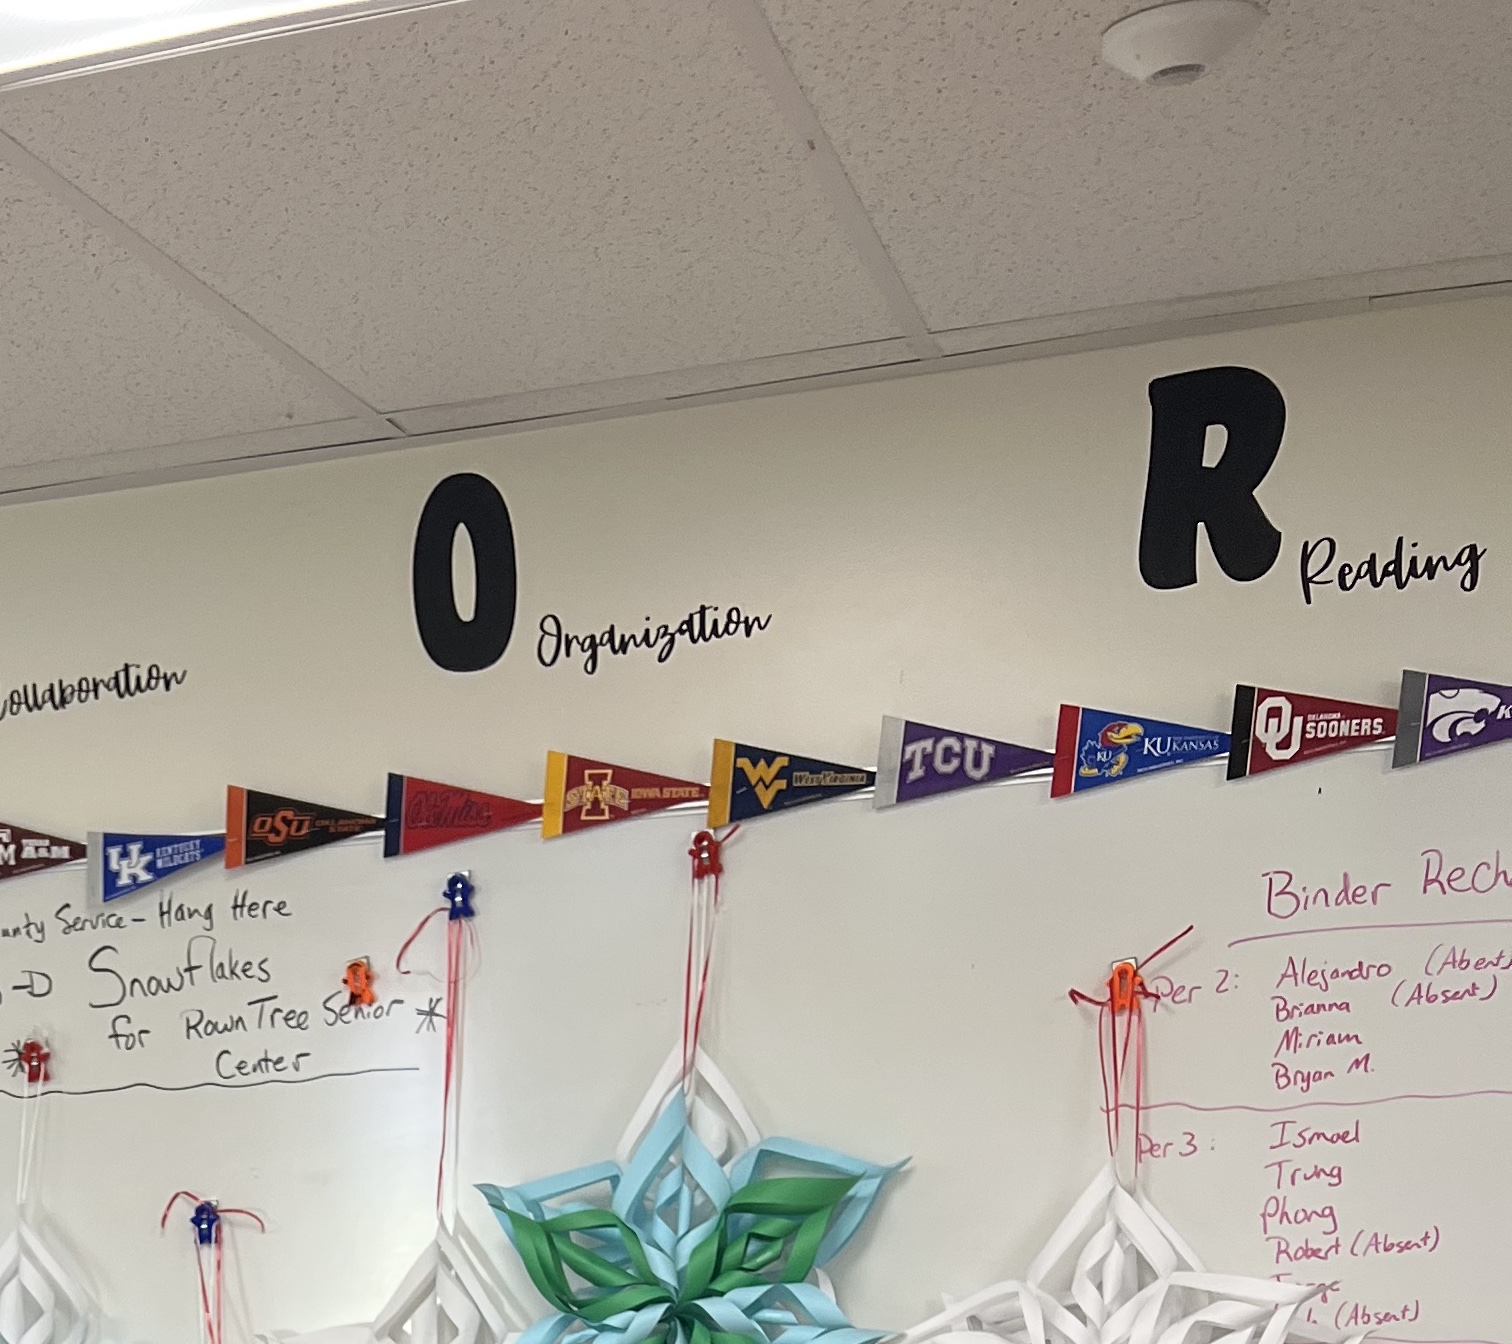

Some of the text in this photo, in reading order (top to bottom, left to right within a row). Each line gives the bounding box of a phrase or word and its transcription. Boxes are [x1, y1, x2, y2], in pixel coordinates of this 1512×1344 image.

[1138, 366, 1287, 589] R
[413, 472, 516, 672] O
[1300, 537, 1487, 604] Reading
[537, 607, 772, 674] Organization
[1172, 740, 1219, 752] KANSAS
[1305, 717, 1384, 739] SOONERS
[904, 737, 996, 784] TCU
[251, 808, 314, 845] OSU
[159, 891, 214, 931] Hang
[232, 888, 293, 921] Here
[1262, 871, 1392, 919] Binder
[88, 936, 272, 1009] Snowflakes
[1276, 956, 1393, 992] Alejandro
[1271, 973, 1498, 1022] Brianna (Absent)
[109, 1014, 152, 1050] for
[323, 991, 405, 1026] Senior
[1274, 1026, 1363, 1059] Miriam
[216, 1050, 311, 1079] Center
[1271, 1062, 1335, 1093] Bryan
[1264, 1159, 1343, 1190] Trung
[1260, 1195, 1338, 1235] Phong
[1265, 1225, 1440, 1264] Robert (Absent)
[1335, 1300, 1420, 1330] (Absent)
